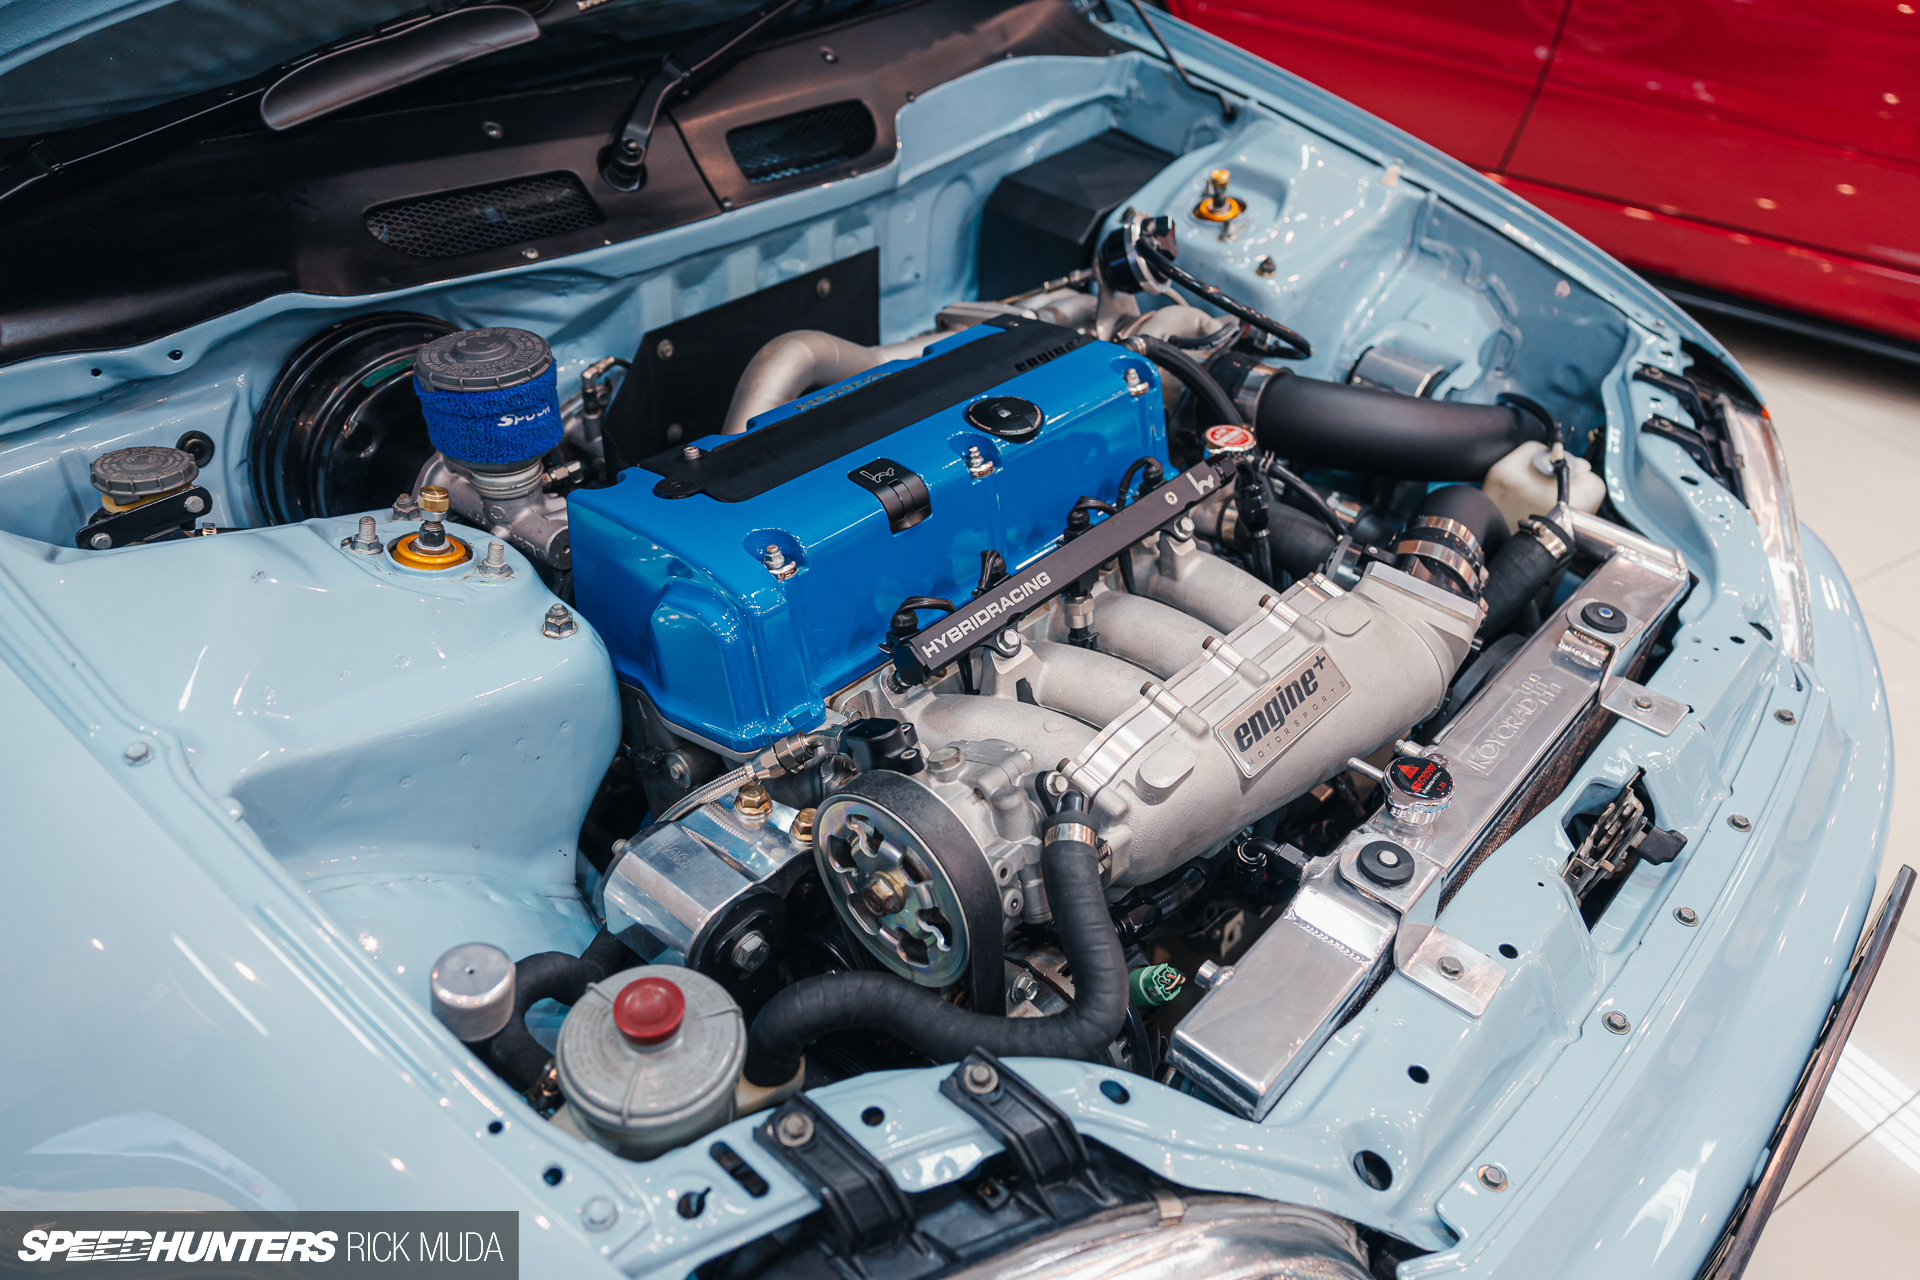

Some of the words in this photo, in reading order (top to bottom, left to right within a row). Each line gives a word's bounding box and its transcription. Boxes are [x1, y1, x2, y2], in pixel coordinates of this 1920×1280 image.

[791, 371, 891, 411] HONDA
[921, 570, 1052, 659] HYBRIDRACING
[1247, 680, 1346, 766] MOTORSPORTS
[1411, 762, 1435, 793] SPOON
